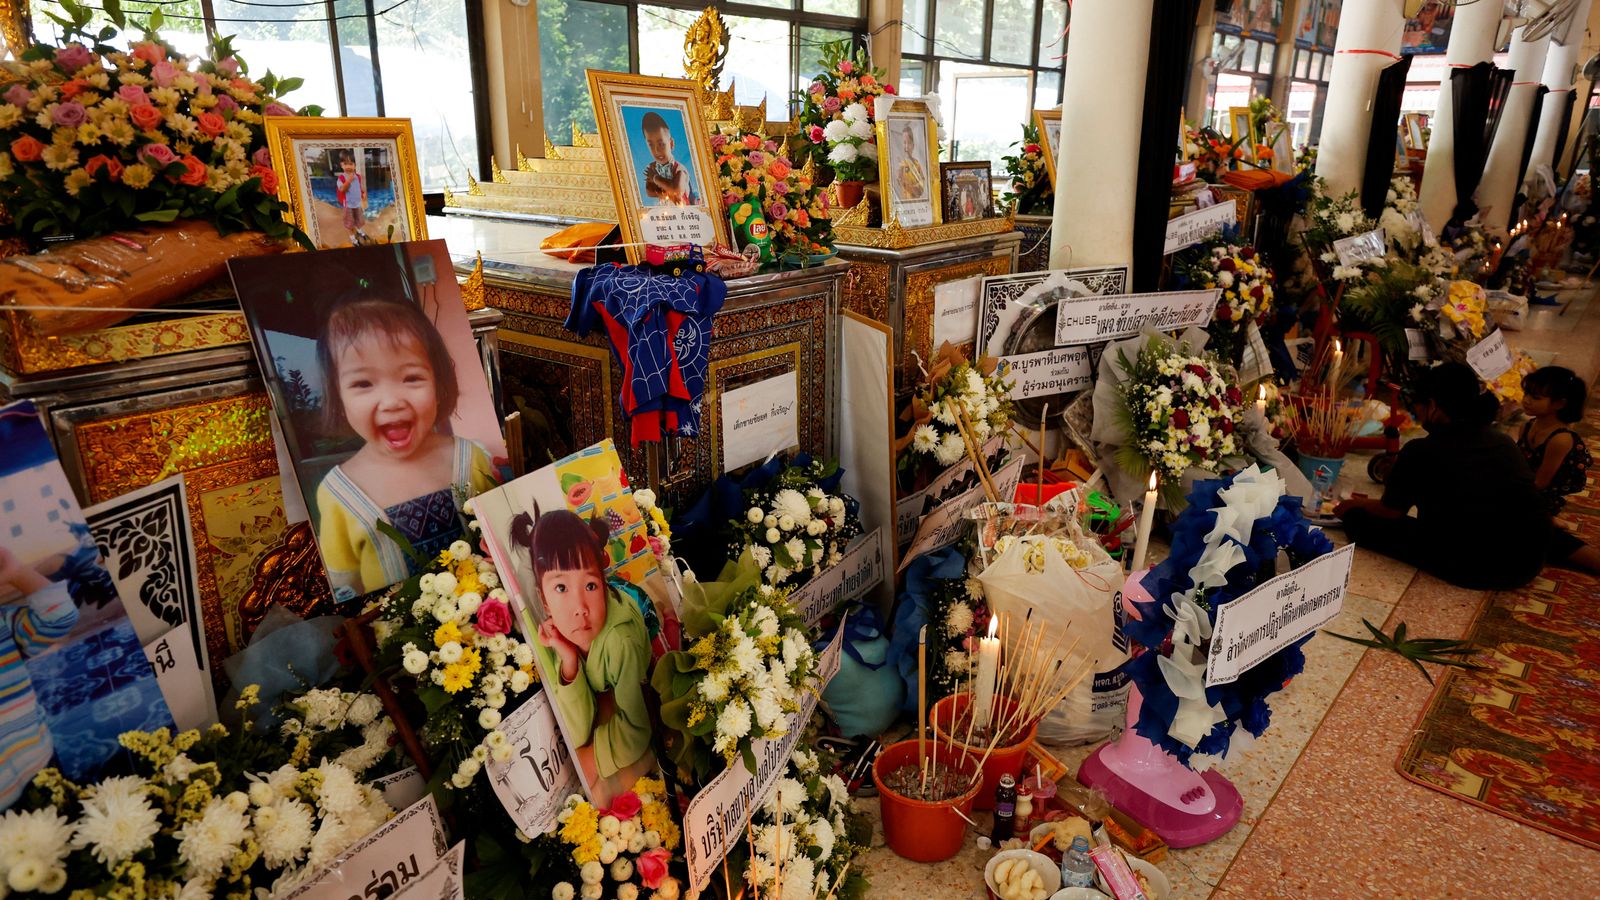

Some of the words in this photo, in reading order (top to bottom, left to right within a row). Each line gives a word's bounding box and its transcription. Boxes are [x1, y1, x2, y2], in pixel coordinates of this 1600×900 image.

[1066, 315, 1098, 326] CHUBB
[1022, 374, 1091, 396] ผู้ร่วมอนุเคราะ
